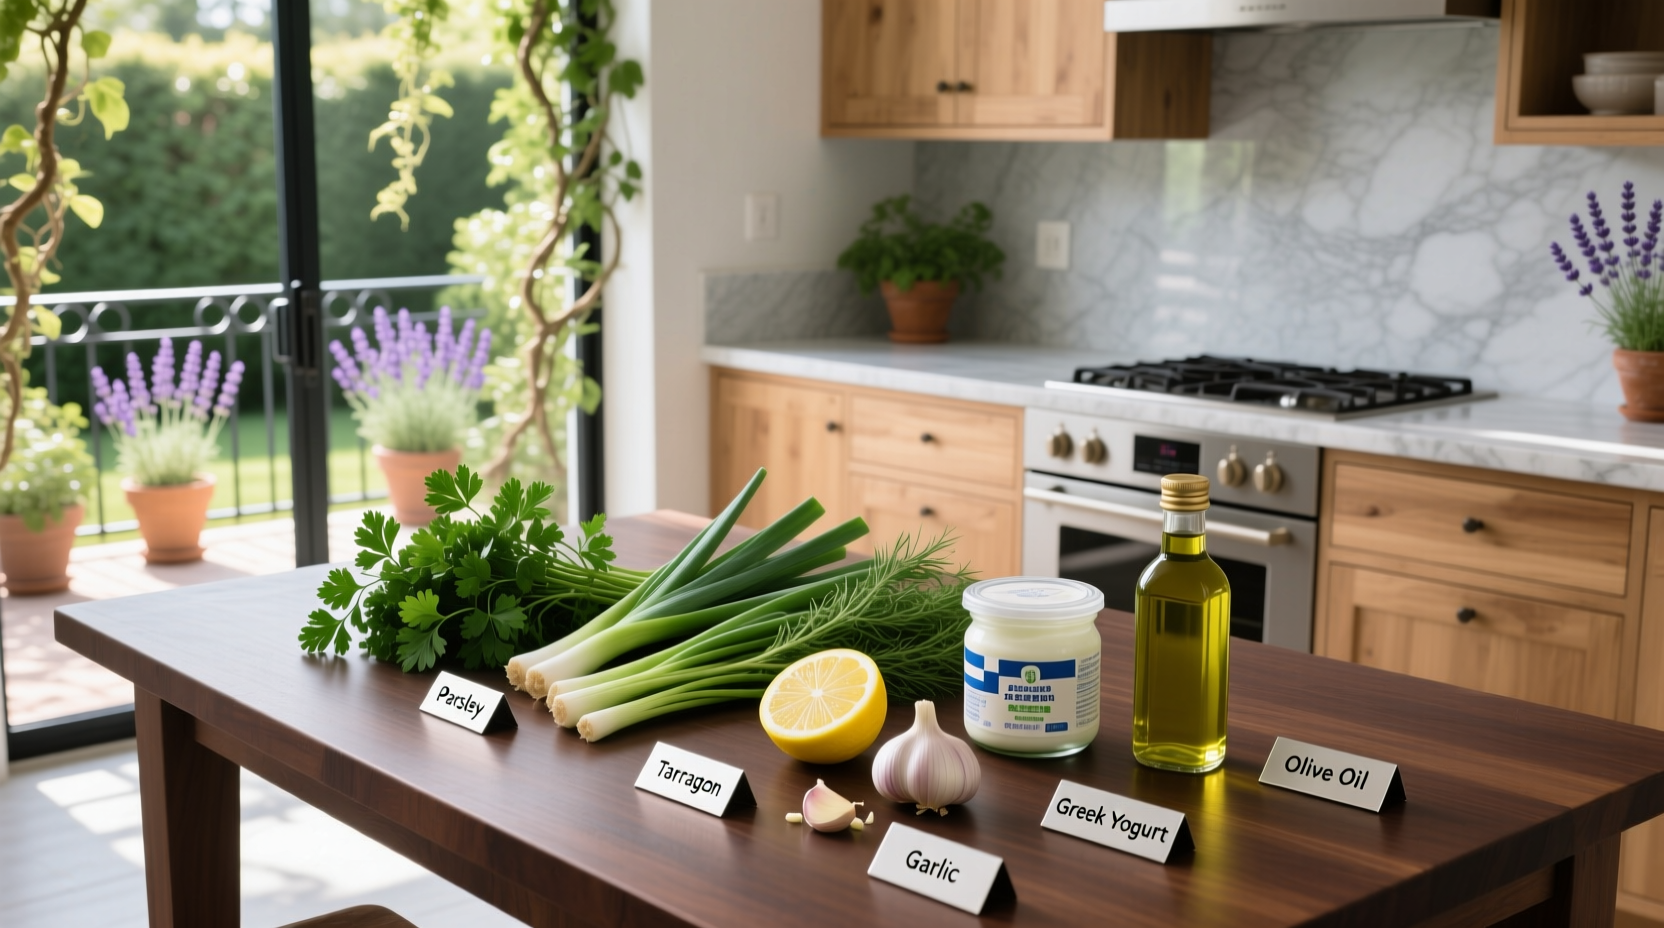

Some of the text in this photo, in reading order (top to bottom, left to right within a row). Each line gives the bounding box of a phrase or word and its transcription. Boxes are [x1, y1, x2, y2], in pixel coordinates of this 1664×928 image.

[436, 686, 485, 720] Parsley
[657, 760, 722, 797] Tarragon
[1284, 755, 1370, 791] Olive Oil
[1055, 797, 1169, 844] Greek Yogurt
[905, 850, 960, 883] Garlic
